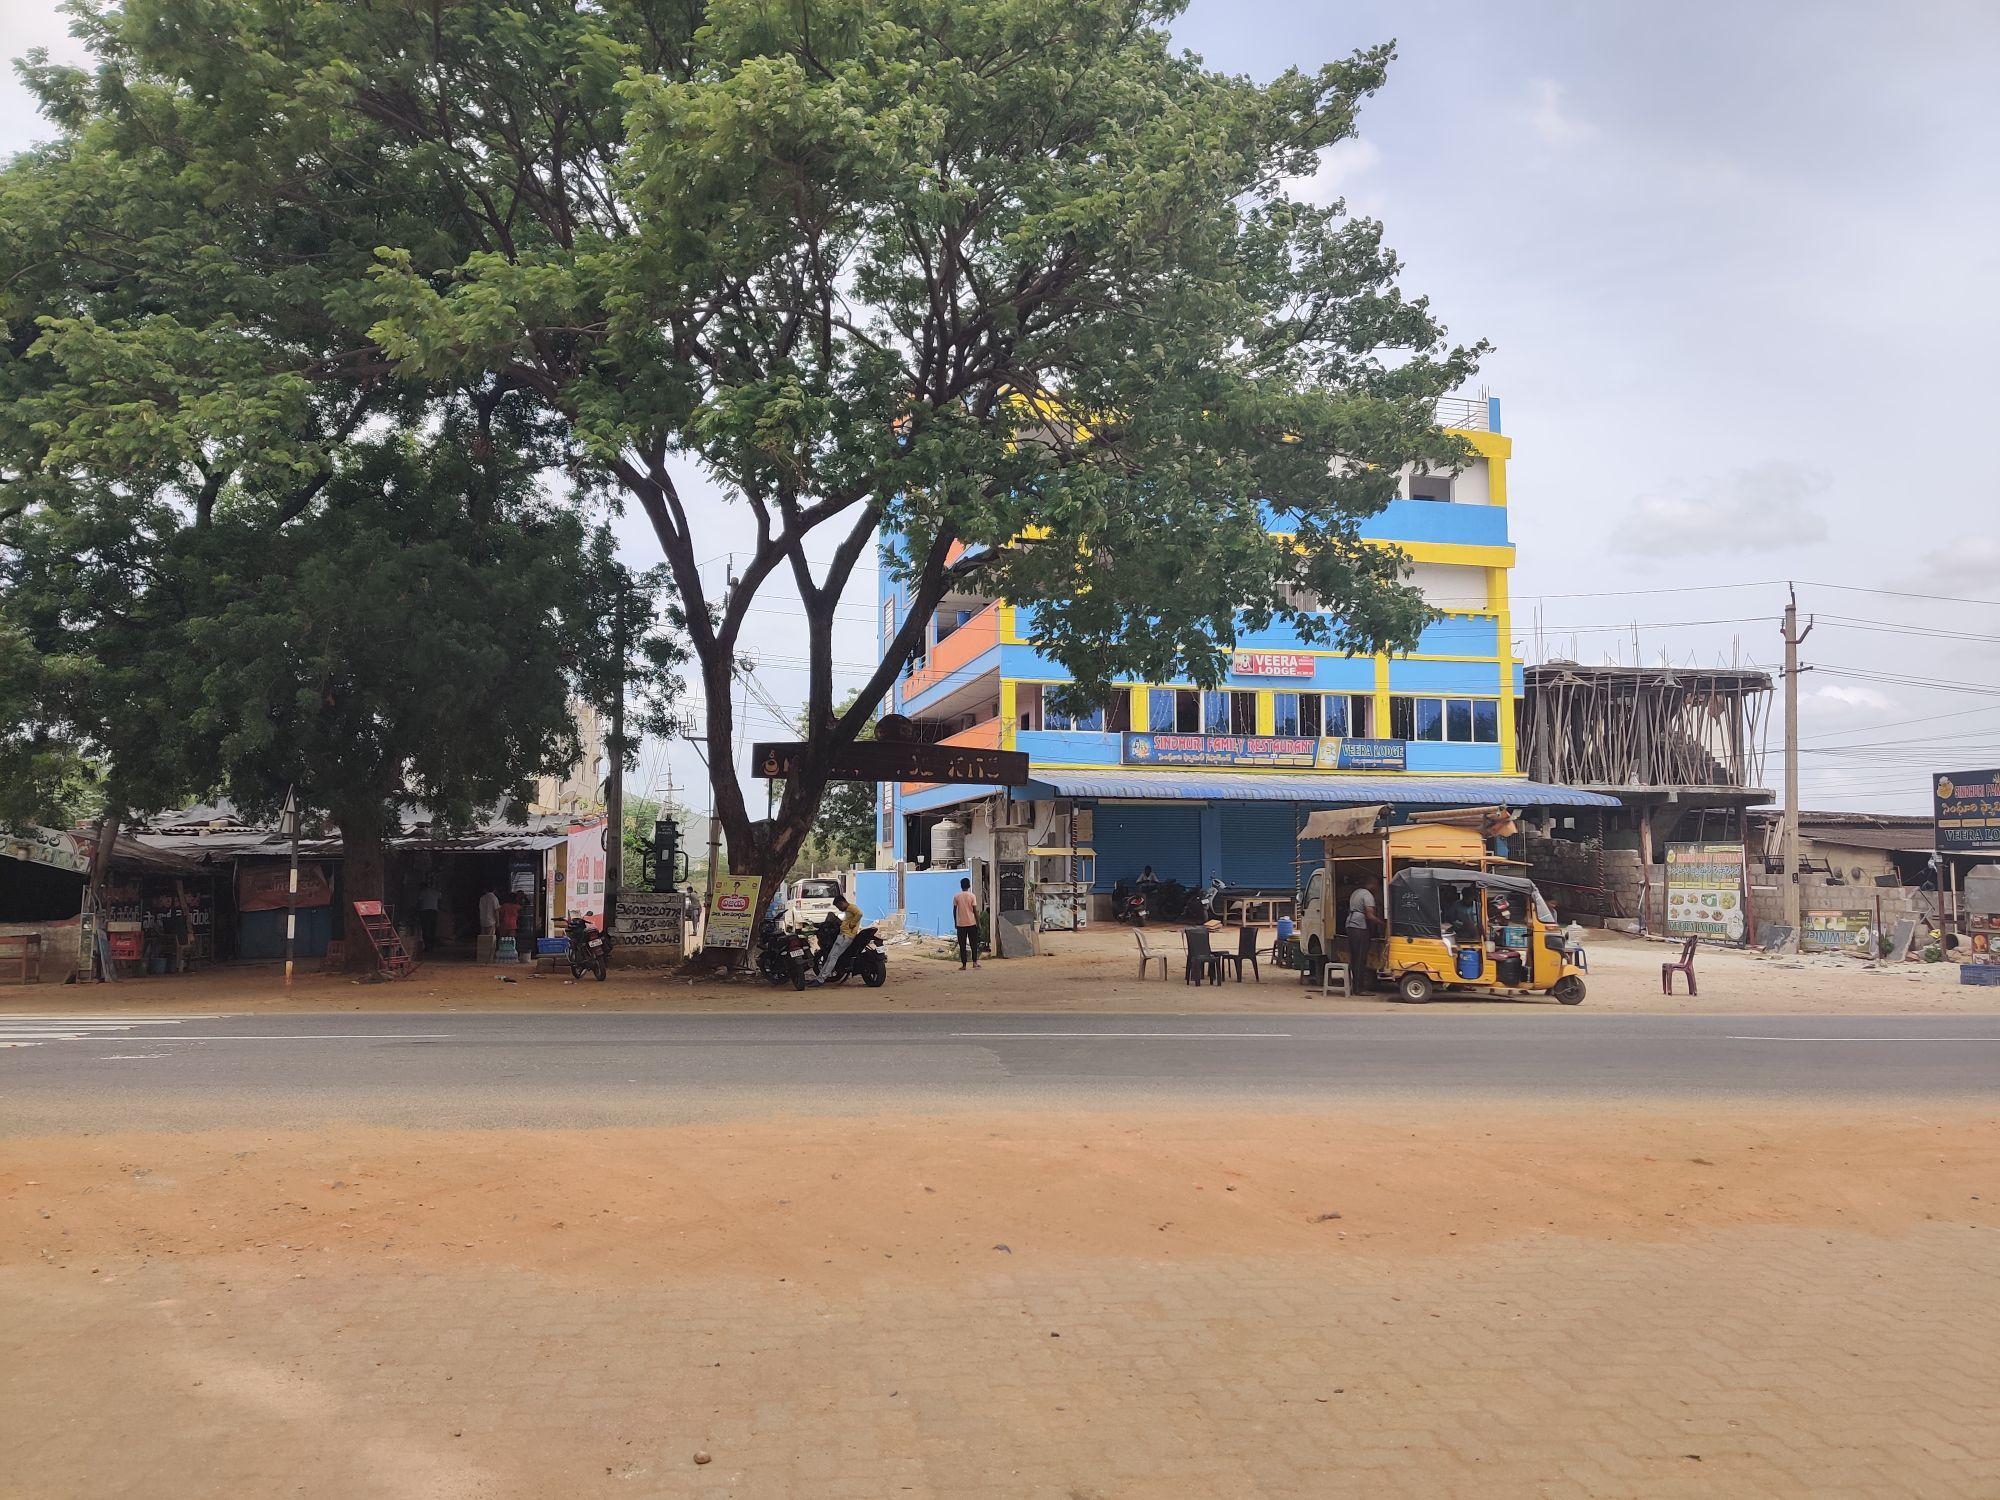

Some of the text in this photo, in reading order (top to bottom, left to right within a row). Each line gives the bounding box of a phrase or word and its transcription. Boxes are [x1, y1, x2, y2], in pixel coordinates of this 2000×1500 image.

[1255, 654, 1298, 667] VEERA
[1258, 666, 1297, 675] LODGE
[1153, 735, 1315, 755] SINDHURI FAMILY RESTAURANT
[1342, 744, 1404, 758] VEERA LODGE
[1954, 784, 1985, 799] SINDHURI
[1944, 829, 1984, 841] VEERA
[1697, 921, 1727, 934] LODGE
[1804, 930, 1841, 944] WINter
